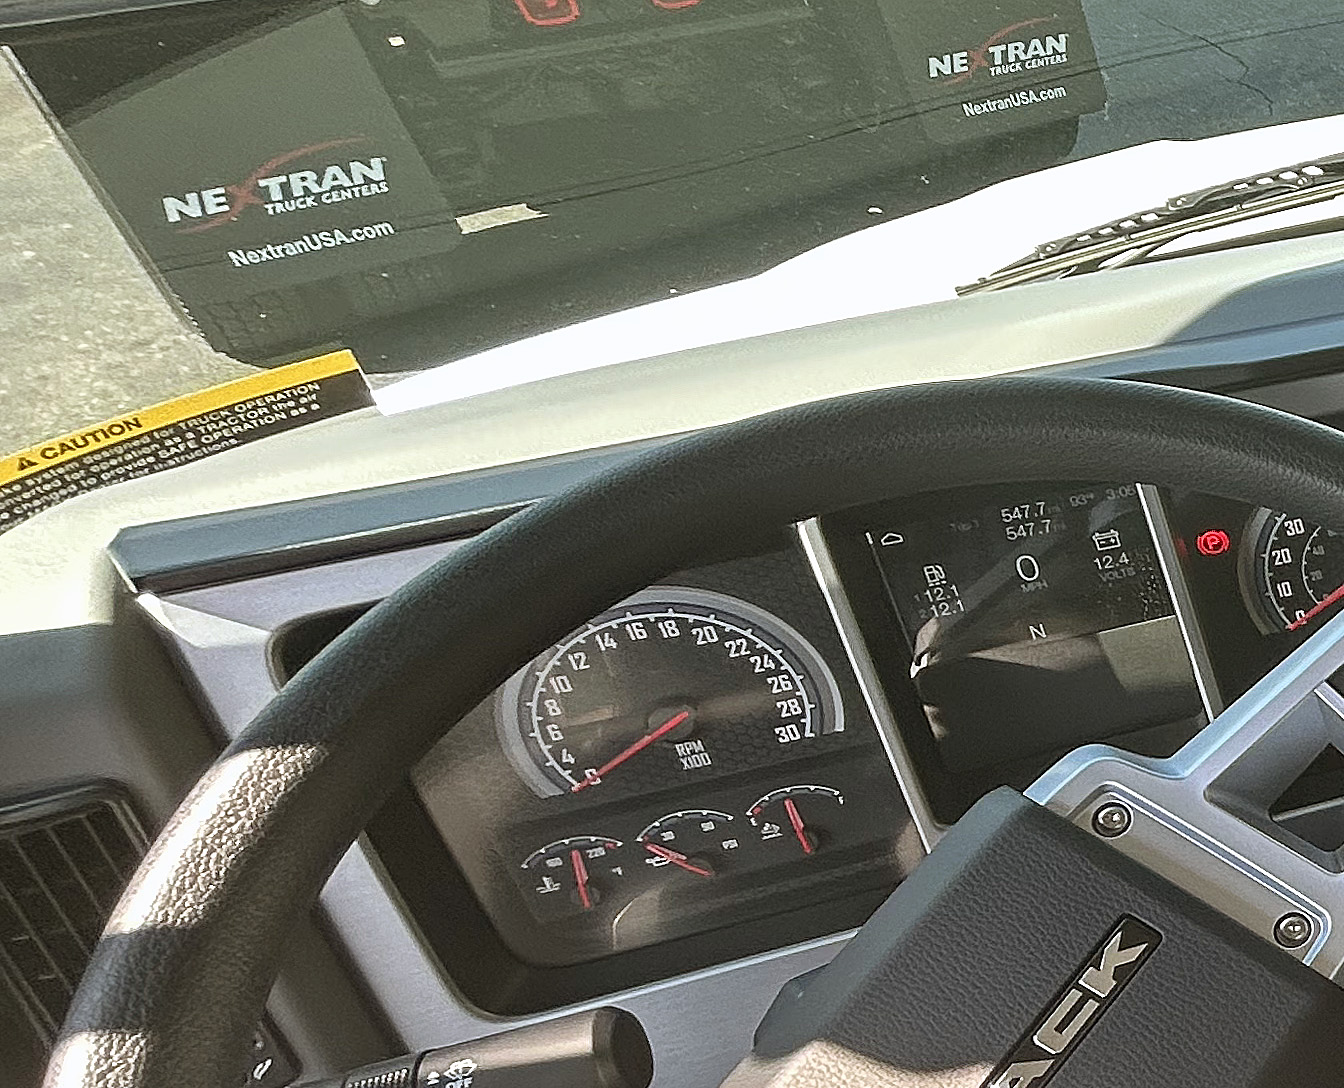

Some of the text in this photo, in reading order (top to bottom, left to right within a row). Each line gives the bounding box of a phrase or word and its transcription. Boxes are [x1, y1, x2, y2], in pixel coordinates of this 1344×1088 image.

[928, 33, 1069, 78] NEXTRAN
[990, 54, 1067, 76] TRUCK CENTERS
[962, 86, 1066, 117] NextranUSA.com
[162, 157, 387, 222] NEXTRAN
[264, 182, 389, 215] TRUCK CENTERS
[228, 222, 395, 267] NextranUSA.com
[153, 427, 175, 439] for
[179, 410, 232, 430] TRUCK
[234, 382, 321, 414] OPERATION
[40, 417, 143, 459] CAUTION
[64, 470, 85, 482] for
[164, 436, 181, 447] as
[185, 431, 196, 439] a
[198, 408, 270, 434] TRACTOR
[272, 399, 296, 411] the
[79, 477, 97, 488] to
[158, 439, 200, 459] SAFE
[200, 411, 288, 444] OPERATION
[289, 407, 308, 417] as
[310, 403, 321, 411] a
[1001, 501, 1045, 523] 547.7
[1005, 519, 1051, 541] 547.7
[1284, 517, 1305, 537] 30
[1093, 551, 1129, 571] 12.4
[1272, 547, 1293, 566] 20
[1015, 554, 1040, 582] 0
[1099, 567, 1136, 582] VOLTS
[923, 584, 960, 602] 12.1
[1020, 580, 1049, 593] MPH
[1276, 581, 1293, 598] 10
[929, 599, 965, 618] 12.1
[625, 622, 648, 640] 16
[658, 620, 680, 638] 18
[692, 626, 719, 645] 20
[1029, 622, 1047, 641] N
[595, 632, 617, 651] 14
[725, 639, 750, 658] 22
[568, 652, 590, 671] 12
[750, 655, 775, 673] 24
[550, 675, 573, 694] 10
[767, 675, 793, 693] 26
[545, 700, 561, 716] 8
[777, 699, 801, 718] 28
[546, 724, 563, 741] 6
[775, 724, 801, 743] 30
[561, 748, 575, 765] 4
[675, 739, 705, 757] RPM
[680, 751, 712, 770] X100
